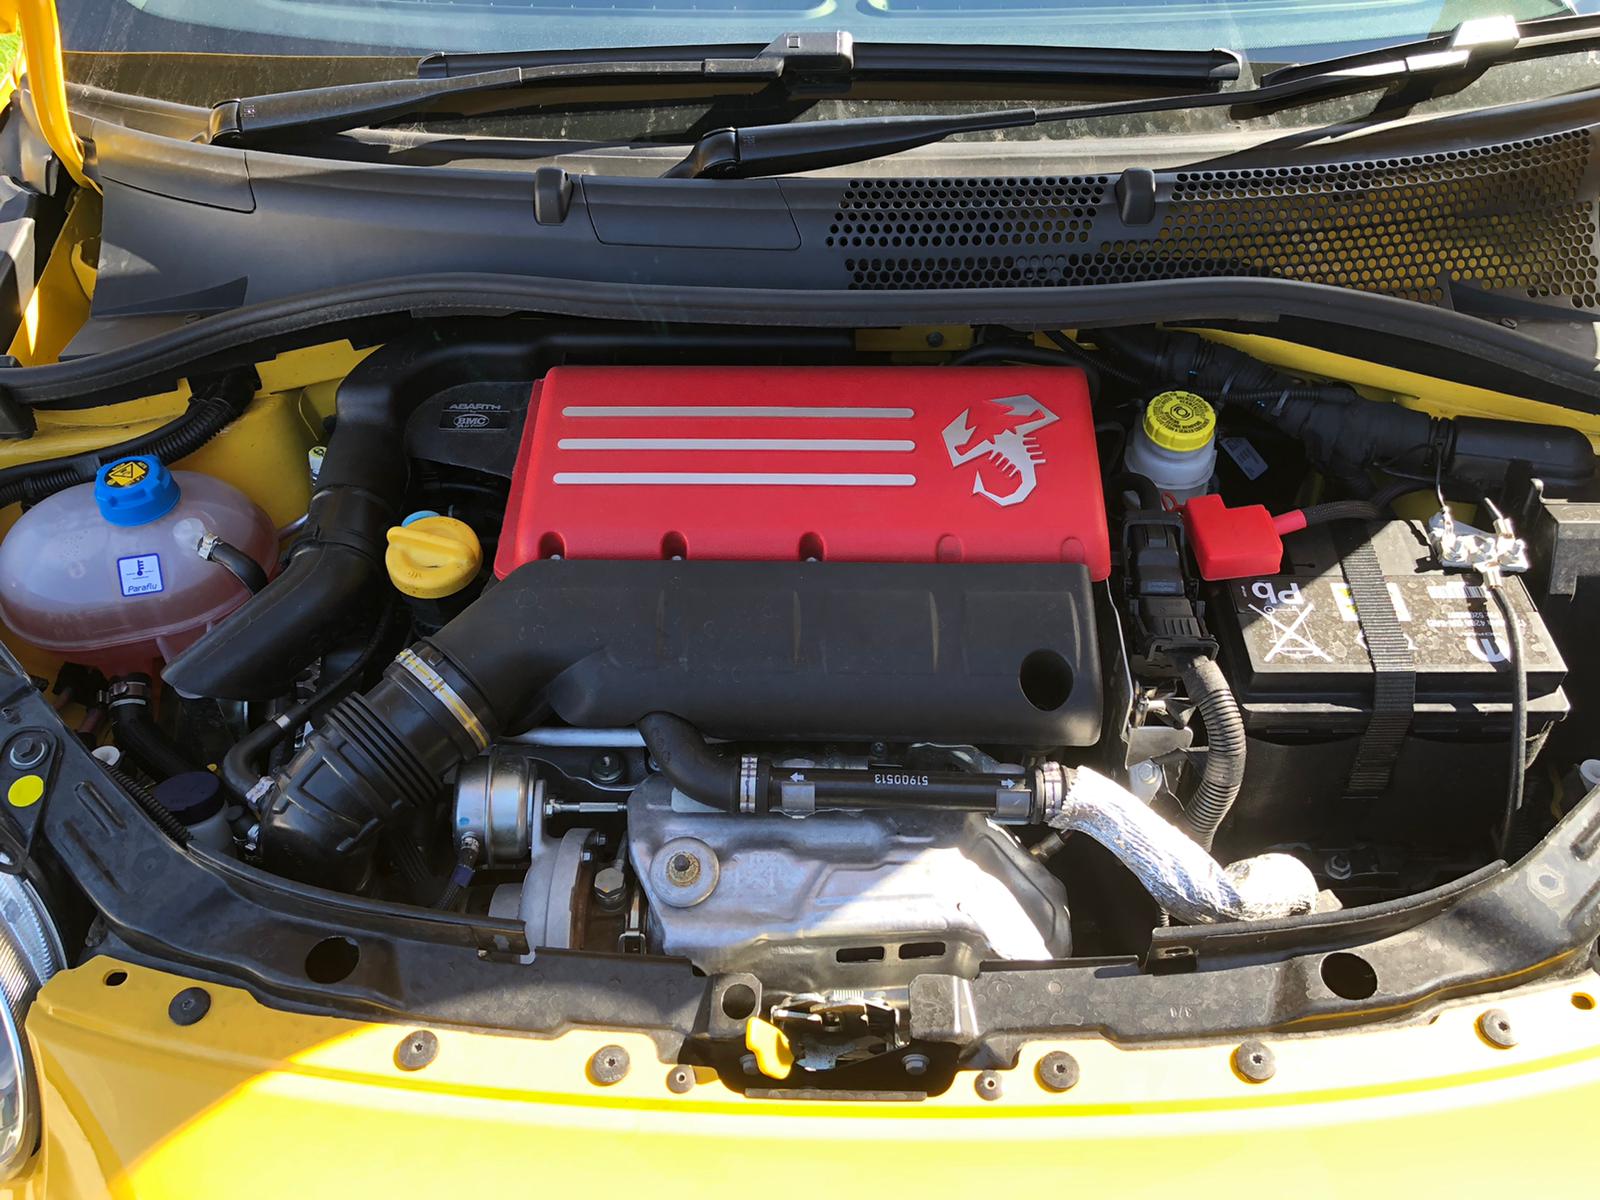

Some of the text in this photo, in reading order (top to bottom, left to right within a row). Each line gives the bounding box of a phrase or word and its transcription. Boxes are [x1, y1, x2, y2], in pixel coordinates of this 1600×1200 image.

[457, 417, 487, 425] BMC
[127, 582, 158, 593] Paraflu
[1251, 582, 1305, 605] Pb
[874, 774, 929, 786] 51900513
